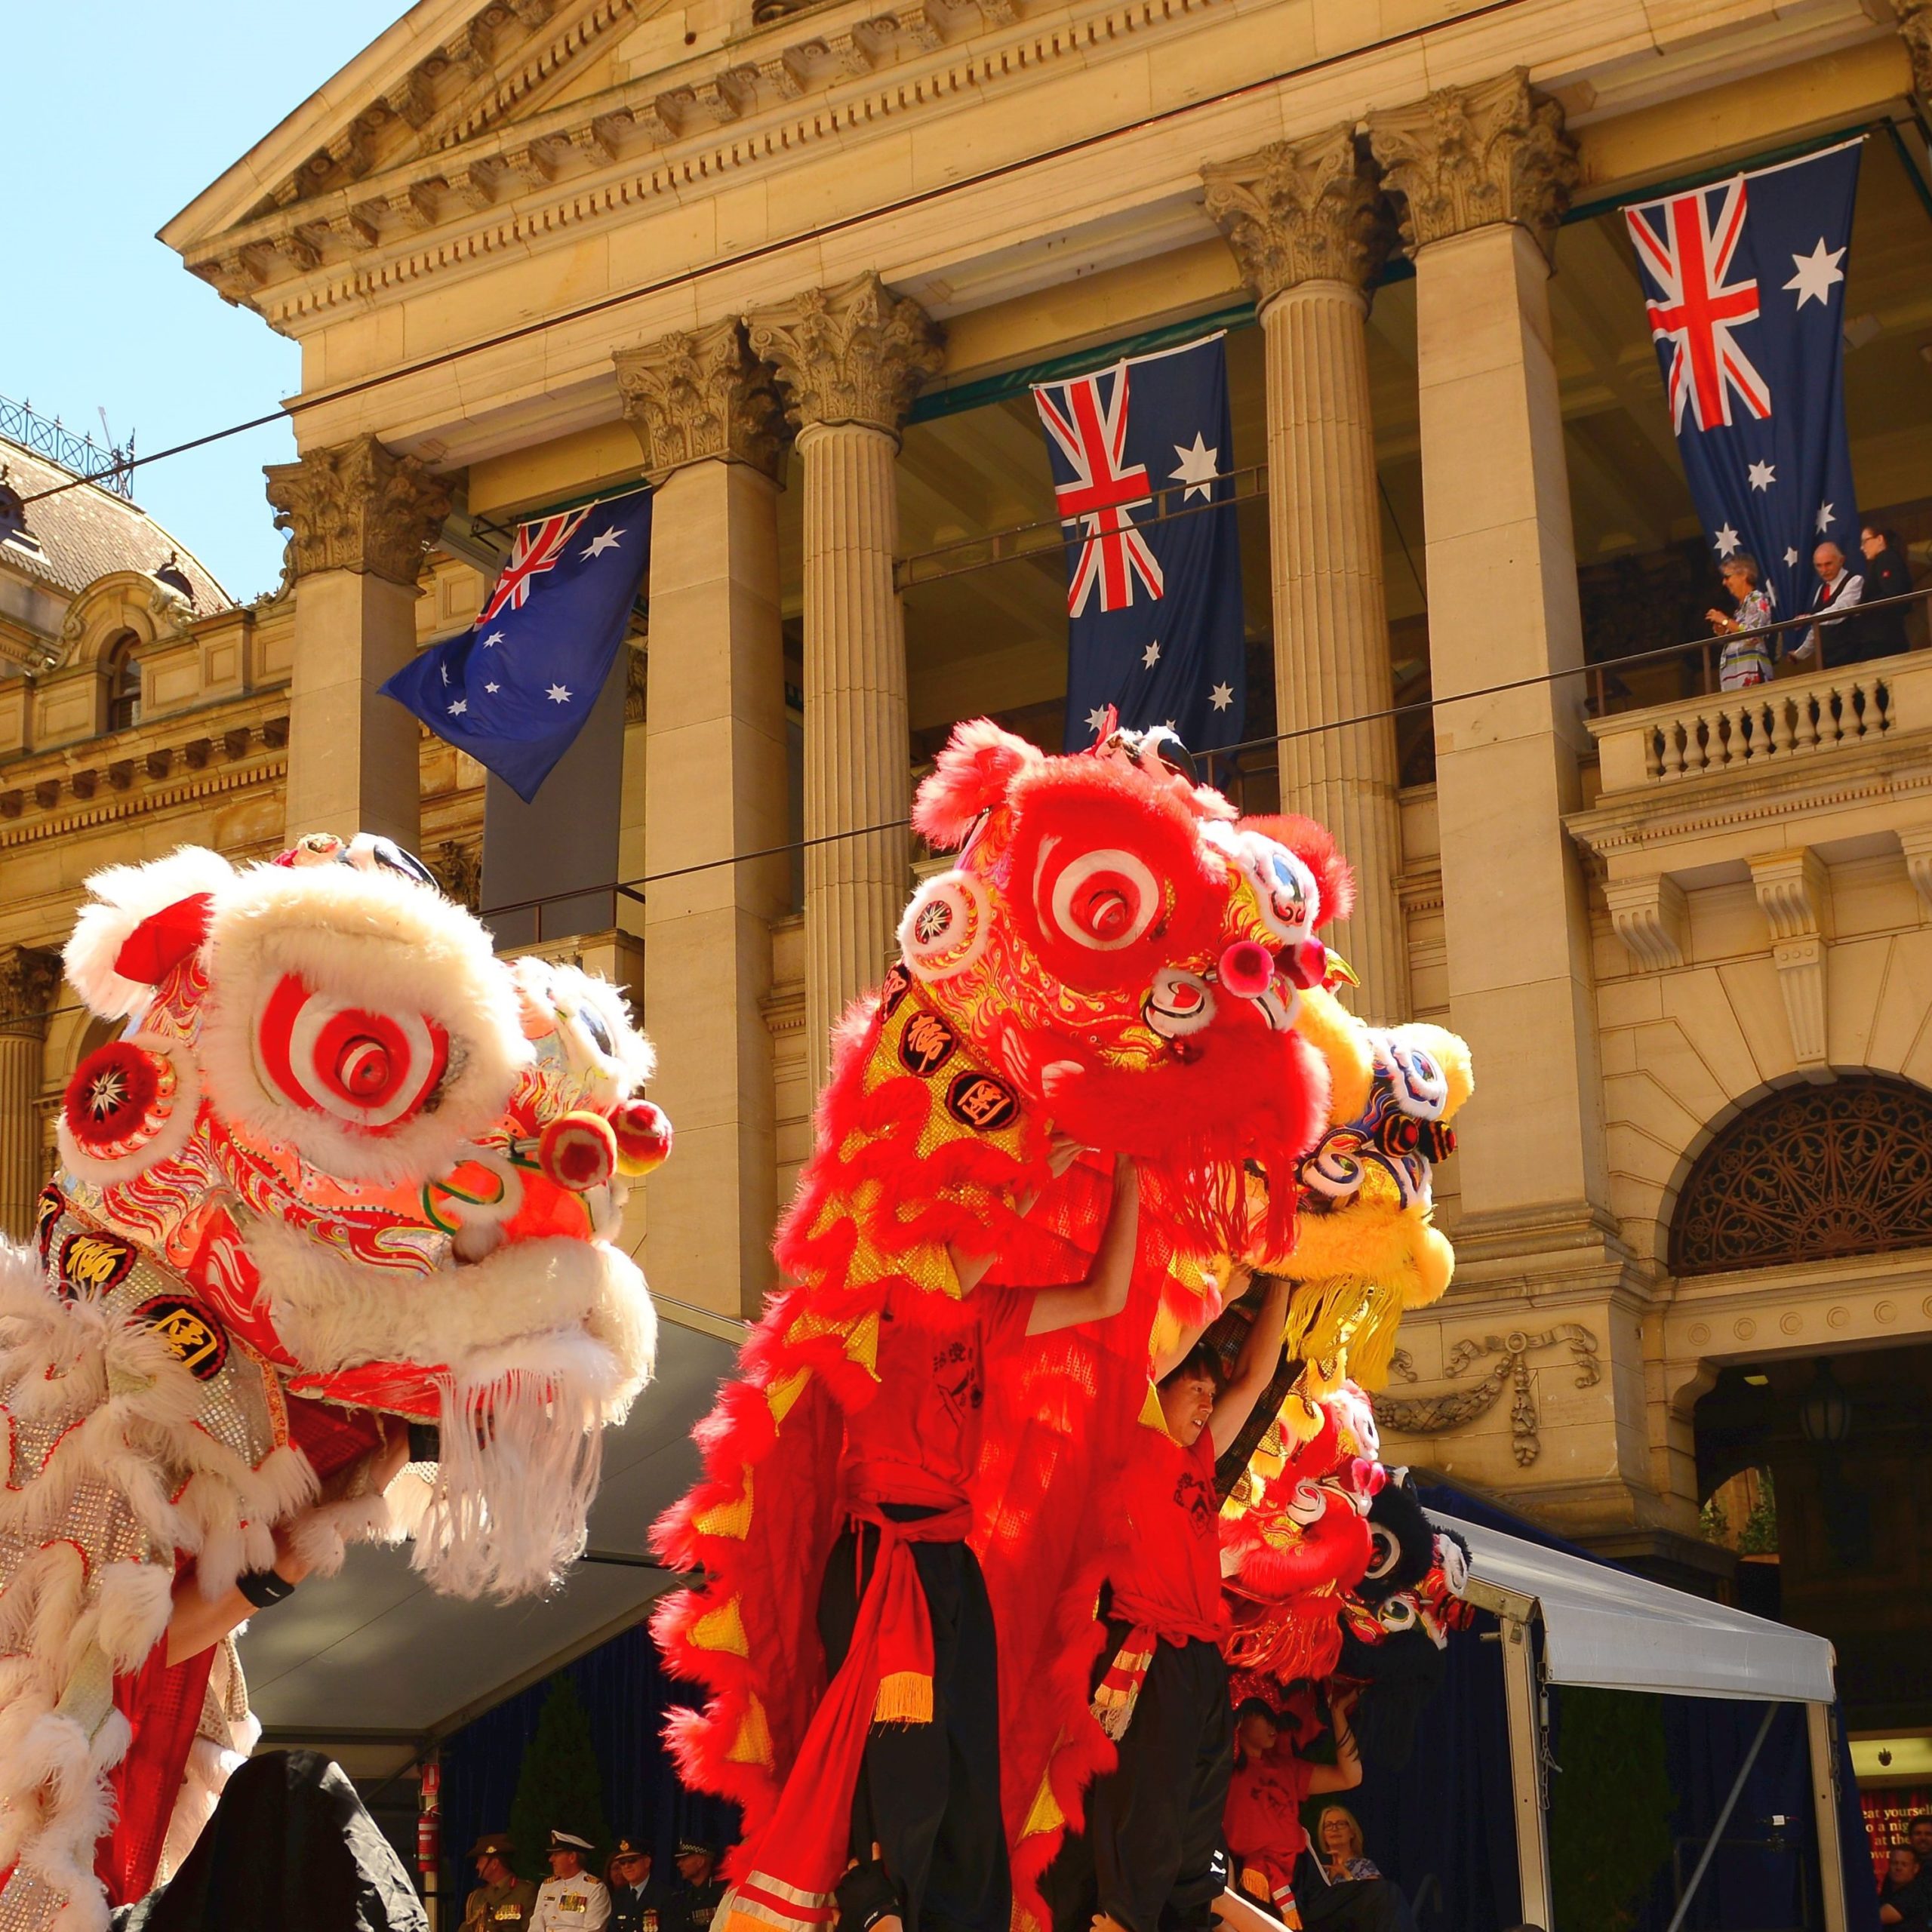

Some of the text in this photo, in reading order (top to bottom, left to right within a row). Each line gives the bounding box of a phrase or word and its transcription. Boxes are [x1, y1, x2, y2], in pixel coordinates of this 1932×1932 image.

[1878, 1823, 1885, 1832] a
[1875, 1833, 1911, 1846] at the
